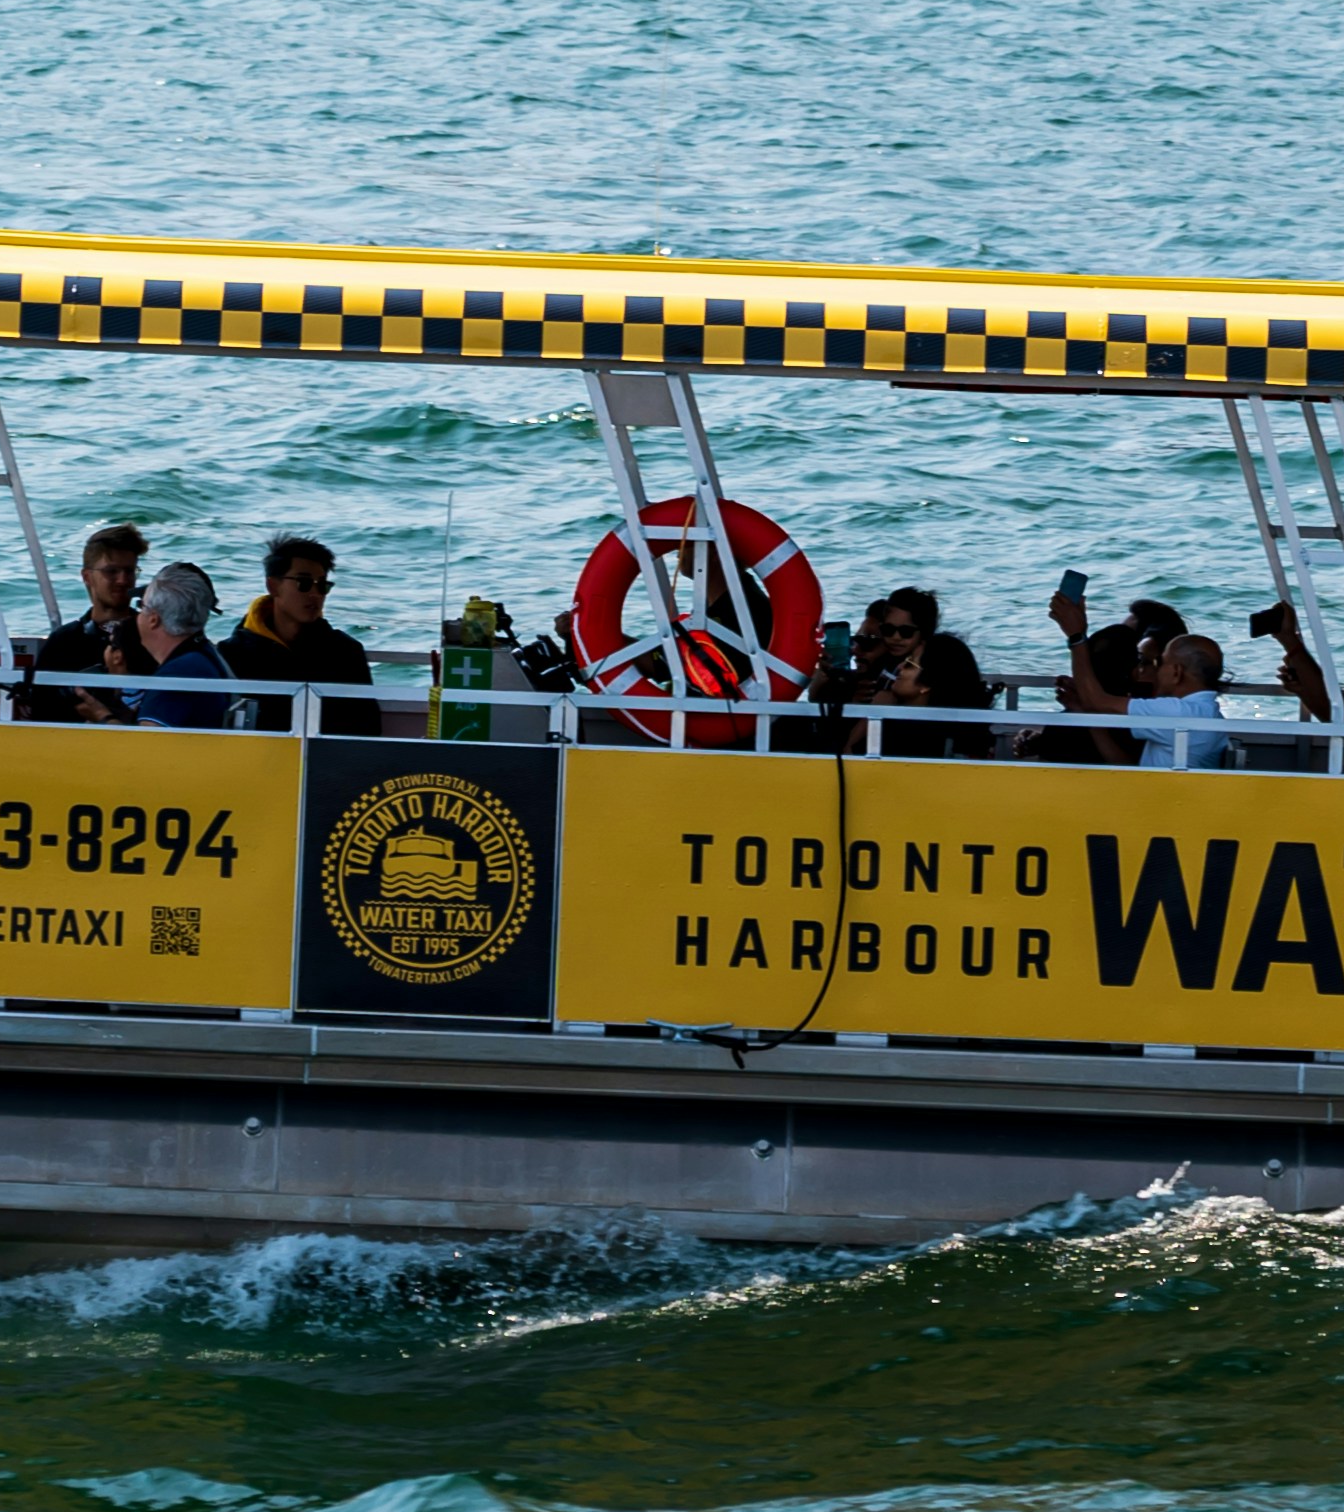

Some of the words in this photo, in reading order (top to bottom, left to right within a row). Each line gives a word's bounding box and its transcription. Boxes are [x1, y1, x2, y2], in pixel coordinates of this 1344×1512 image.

[383, 774, 478, 797] @TOWATERTAXI
[345, 795, 423, 876] TORONTO
[433, 795, 512, 883] HARBOUR
[681, 833, 1049, 898] TORONTO
[359, 905, 436, 930] WATER
[442, 909, 493, 932] TAXI
[391, 936, 420, 954] EST
[424, 937, 460, 956] 1995
[675, 914, 1052, 980] HARBOUR
[368, 956, 481, 984] TOWATERTAXI.COM
